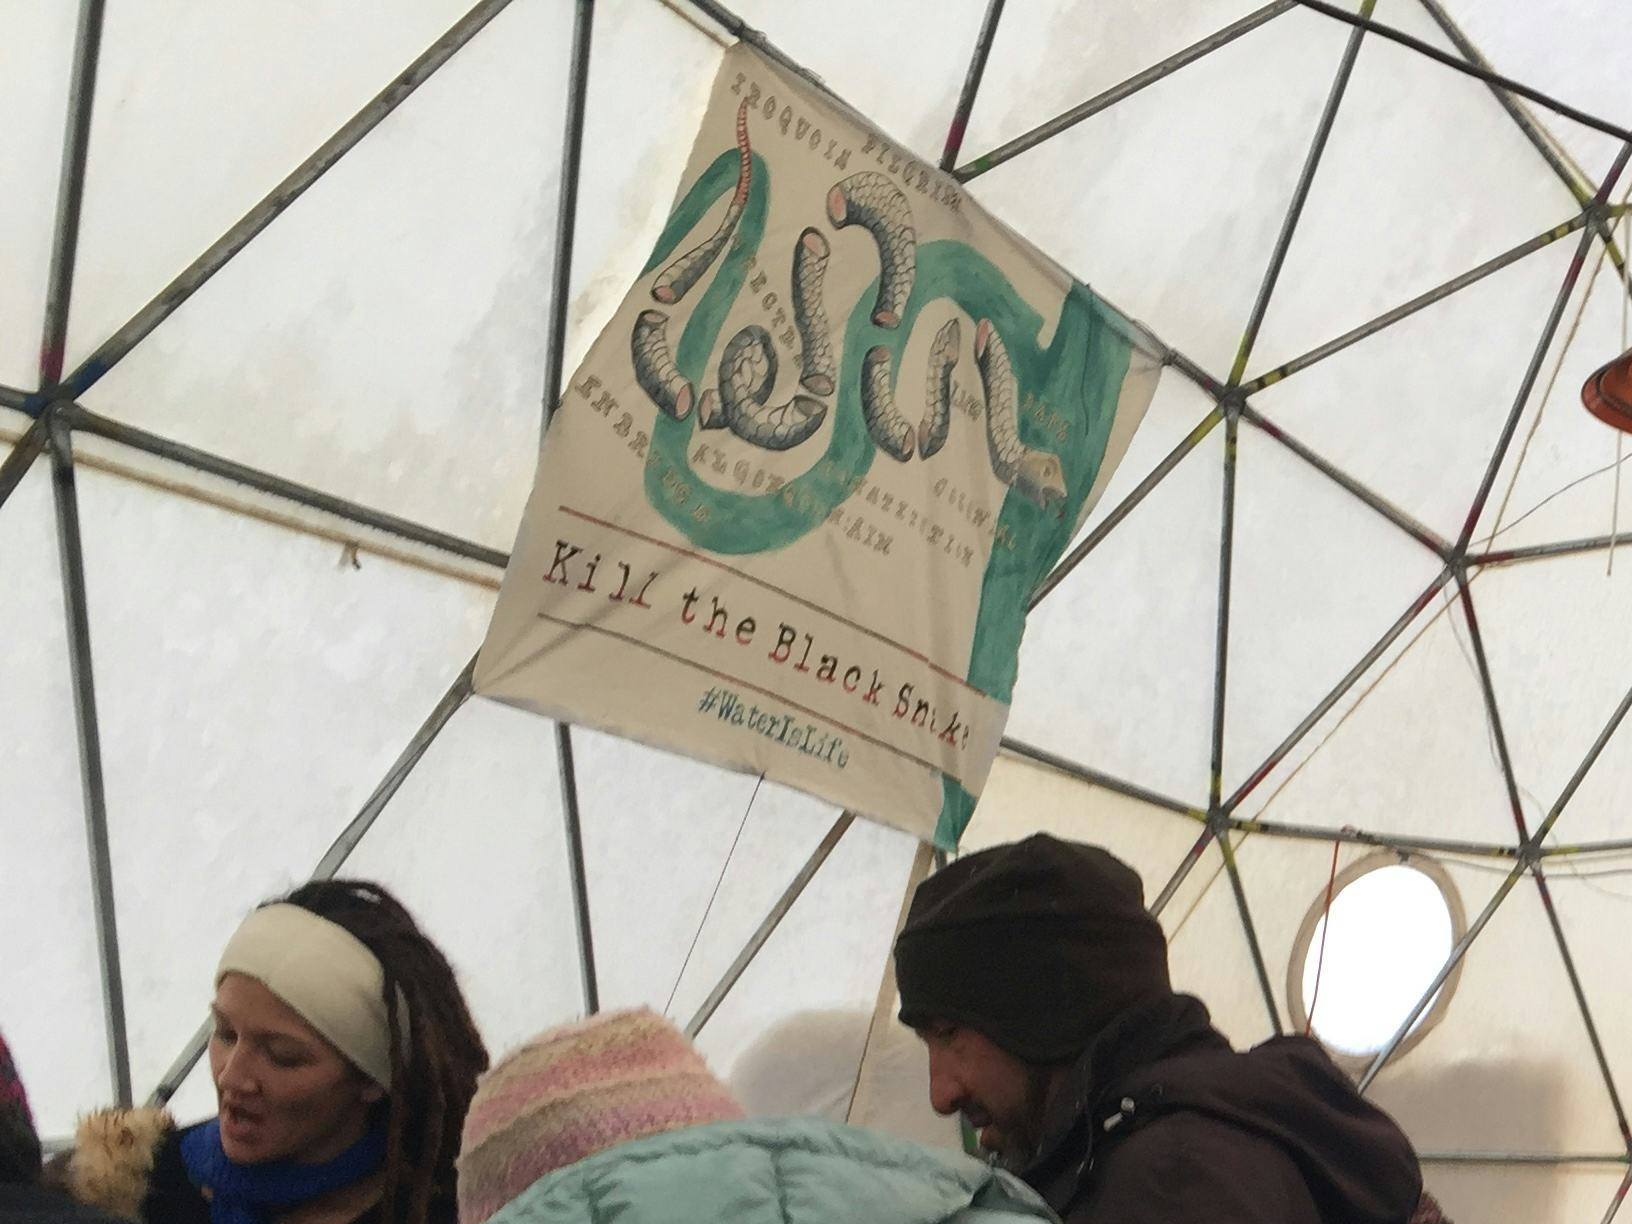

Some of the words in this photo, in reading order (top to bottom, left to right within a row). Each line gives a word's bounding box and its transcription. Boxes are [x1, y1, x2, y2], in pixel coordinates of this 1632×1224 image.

[543, 539, 660, 609] Kill
[681, 586, 757, 645] the
[768, 621, 886, 707] Black
[698, 686, 850, 769] #WaterIsLife
